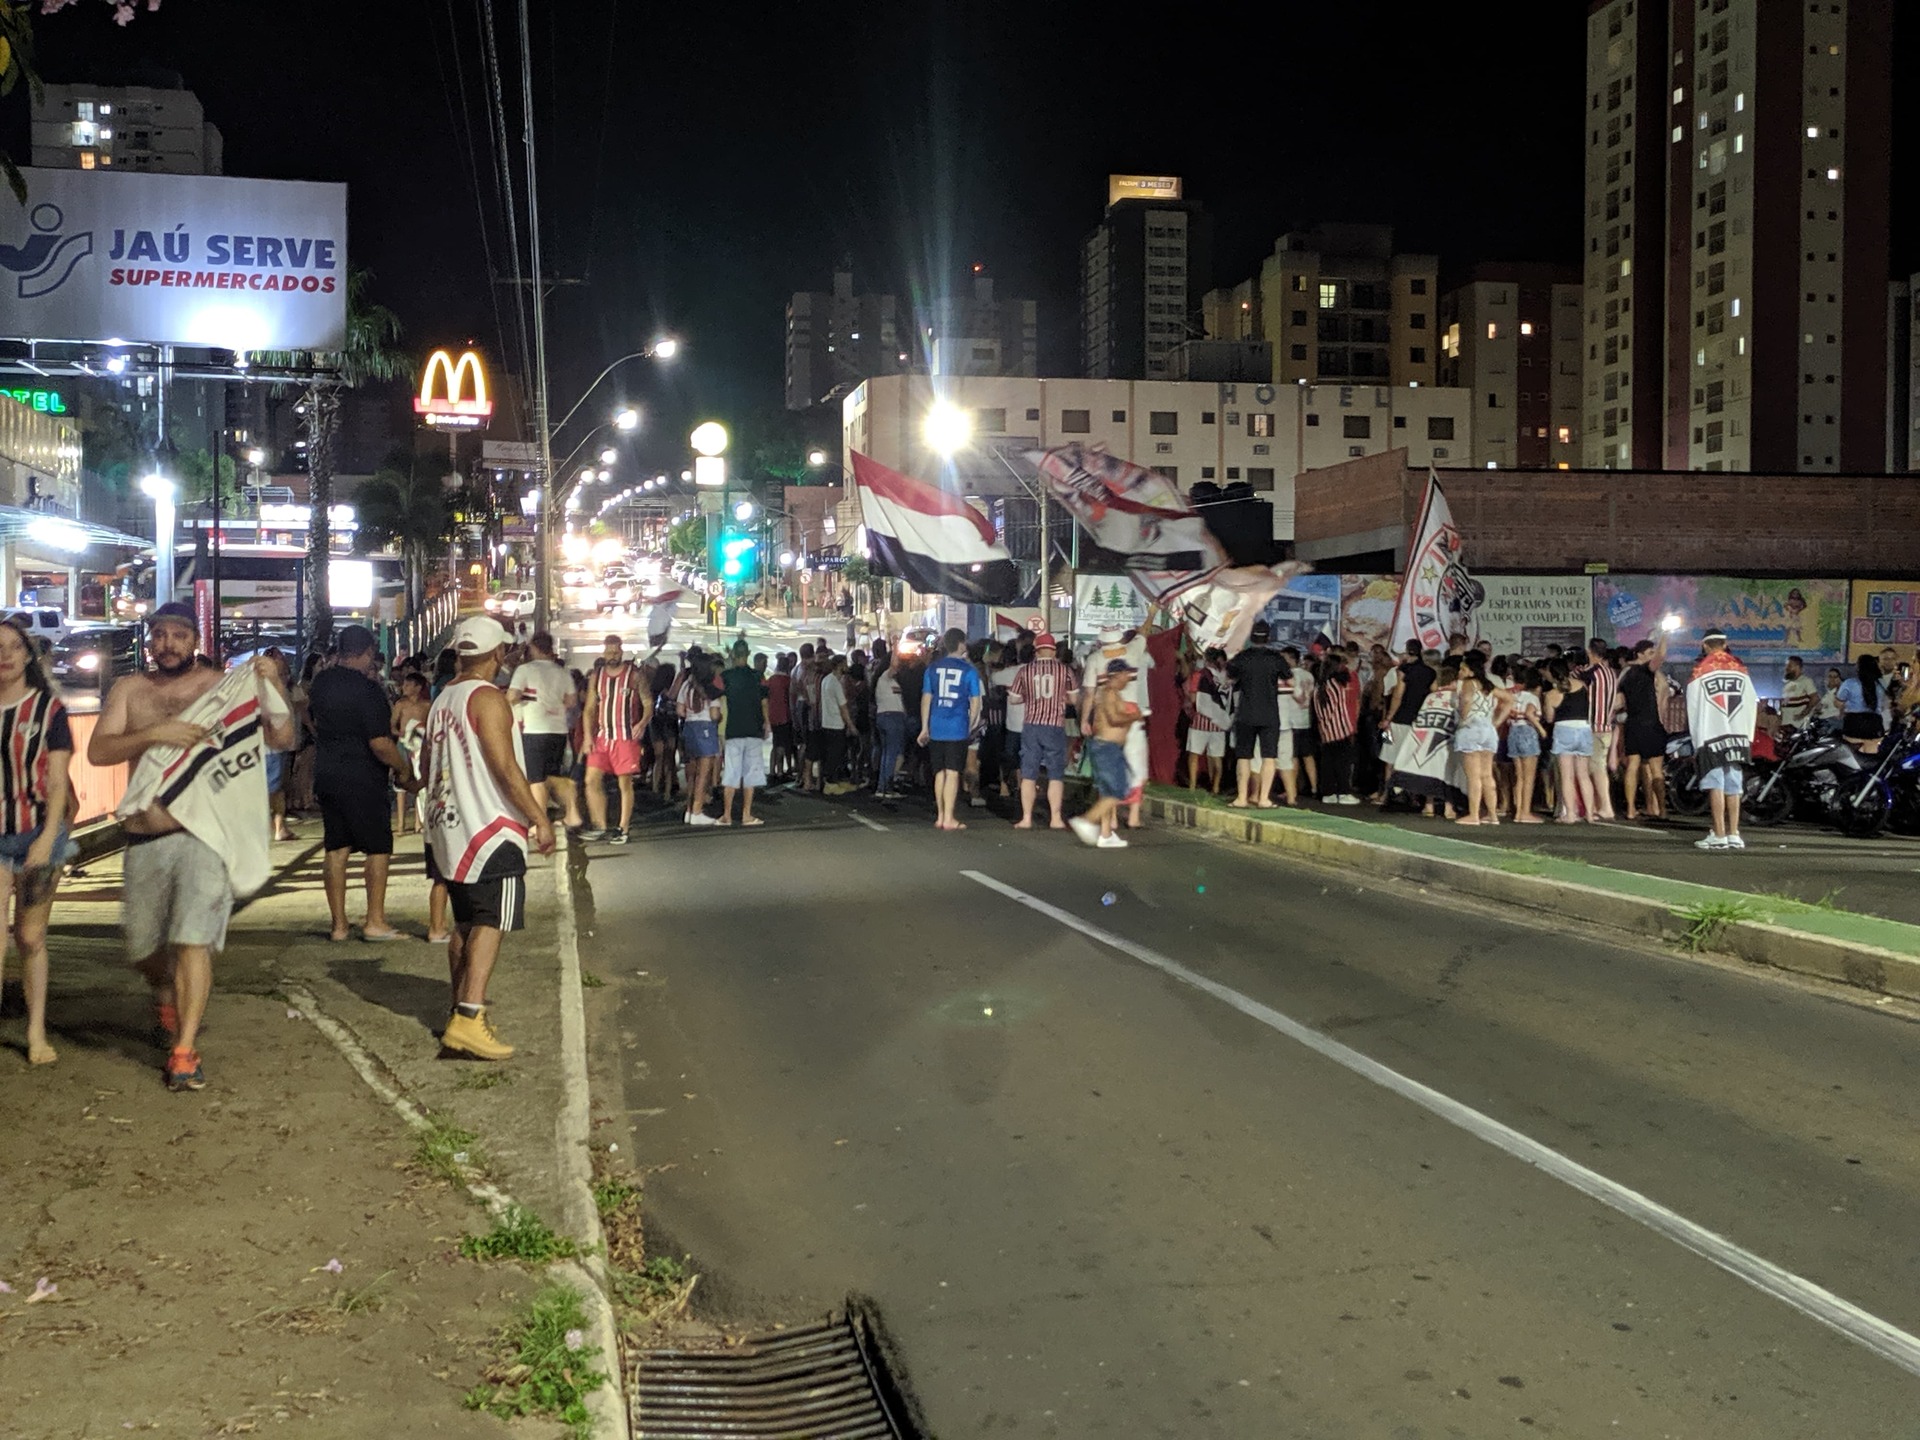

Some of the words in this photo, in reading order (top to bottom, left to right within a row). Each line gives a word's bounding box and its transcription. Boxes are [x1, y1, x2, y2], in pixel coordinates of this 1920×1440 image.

[109, 223, 191, 263] JAÚ
[206, 233, 337, 270] SERVE
[109, 268, 337, 294] SUPERMERCADOS
[1220, 384, 1391, 408] HOTEL
[1488, 599, 1552, 609] ESPERAMOS
[936, 668, 963, 699] 12
[1033, 673, 1055, 700] 10
